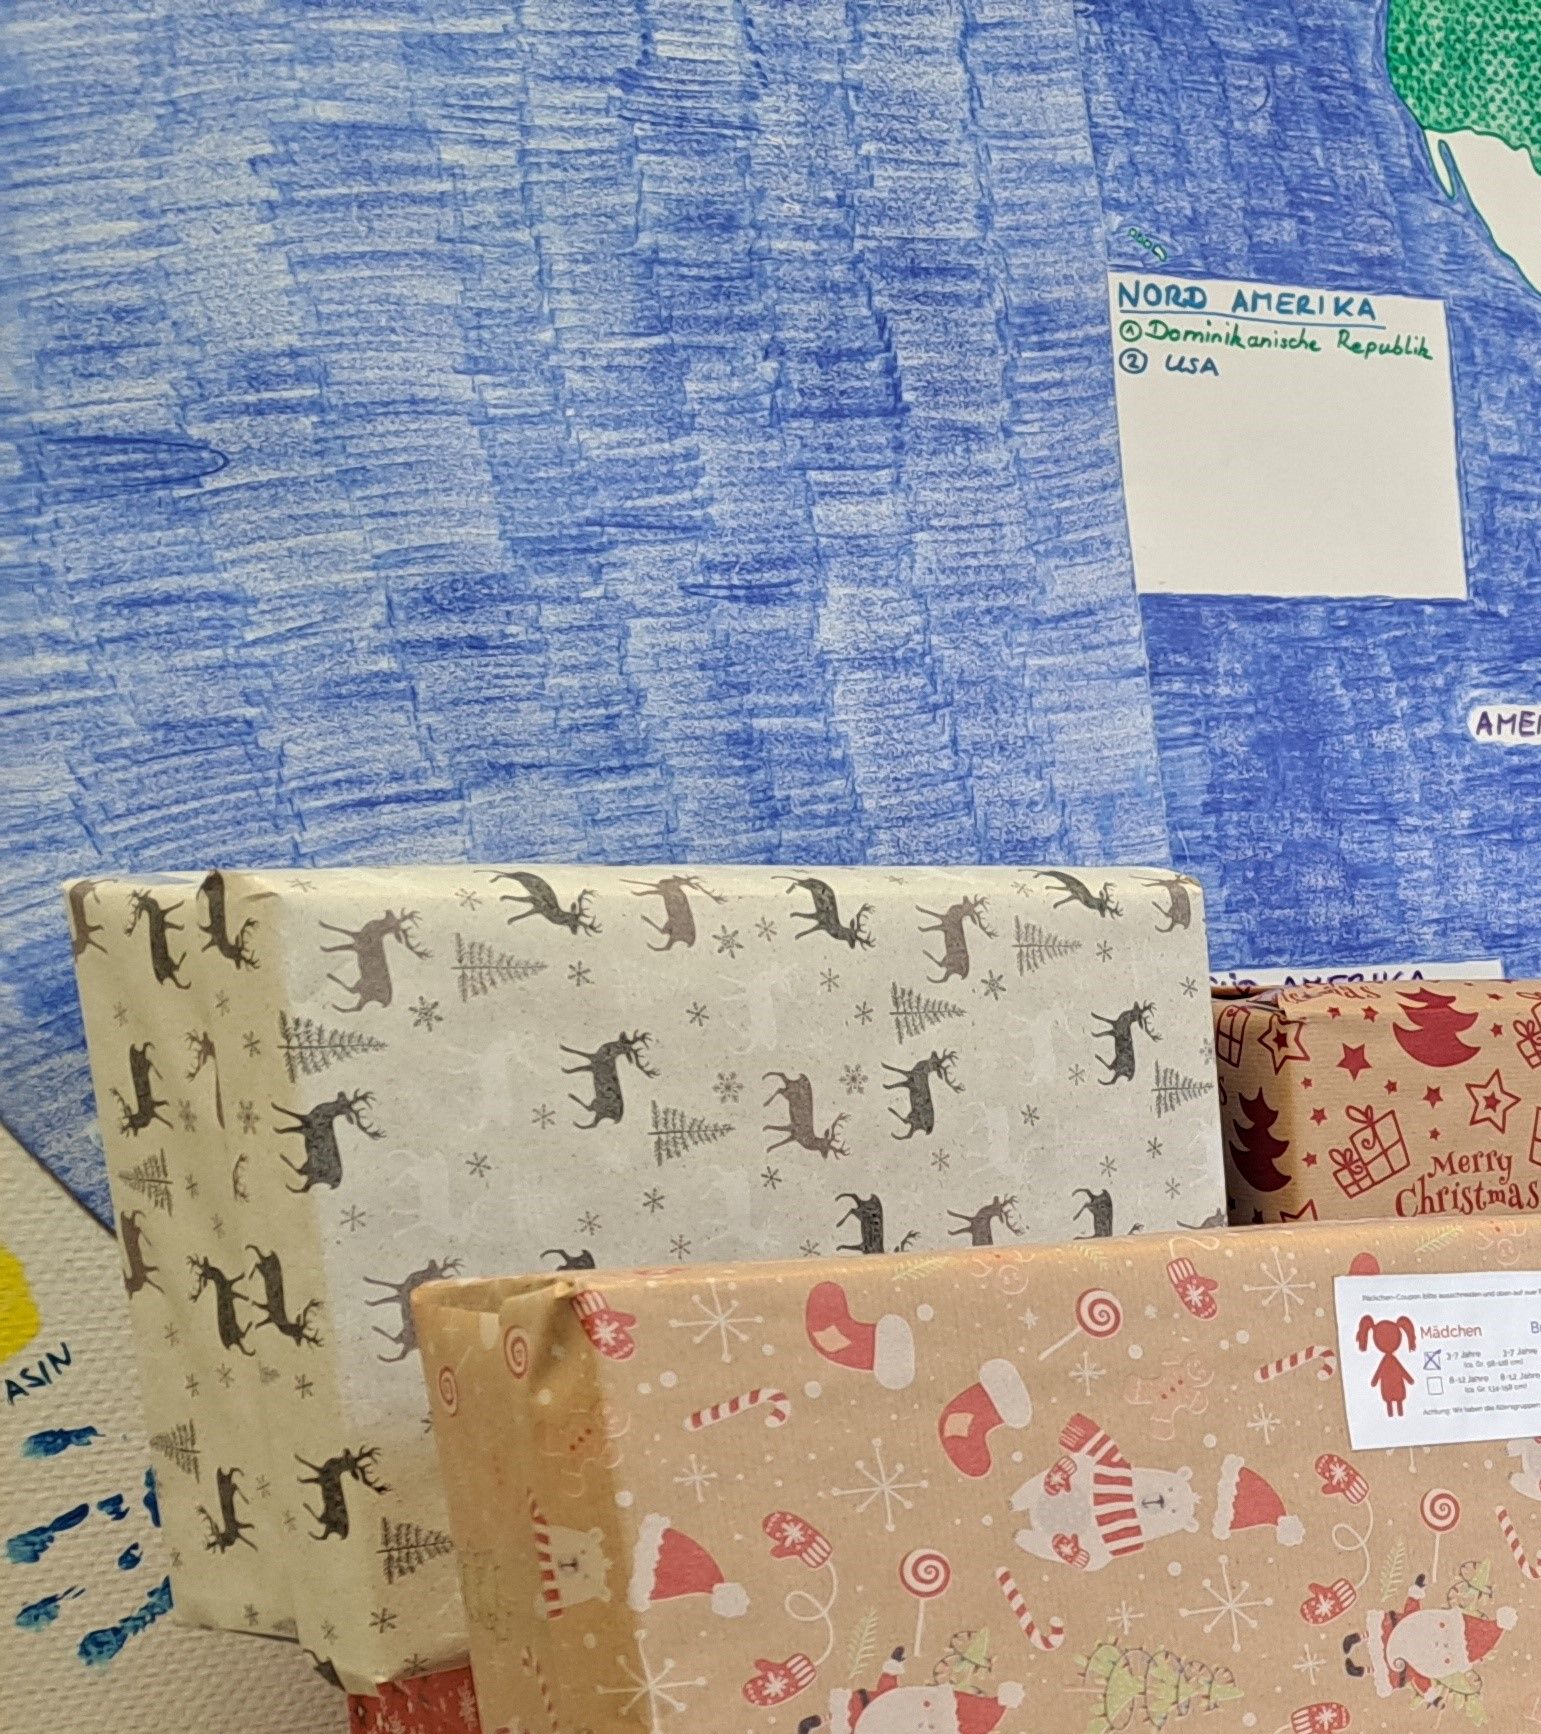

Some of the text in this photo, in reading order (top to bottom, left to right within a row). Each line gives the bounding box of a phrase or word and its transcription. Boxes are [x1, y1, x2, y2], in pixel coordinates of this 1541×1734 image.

[1118, 281, 1377, 321] NORD AMERIKA
[1145, 319, 1321, 352] Dominikanische
[1337, 330, 1433, 360] Republik
[1166, 356, 1219, 376] USA
[1426, 1149, 1513, 1185] Merry
[1395, 1174, 1540, 1218] Christmas
[1420, 1324, 1482, 1339] Mädchen
